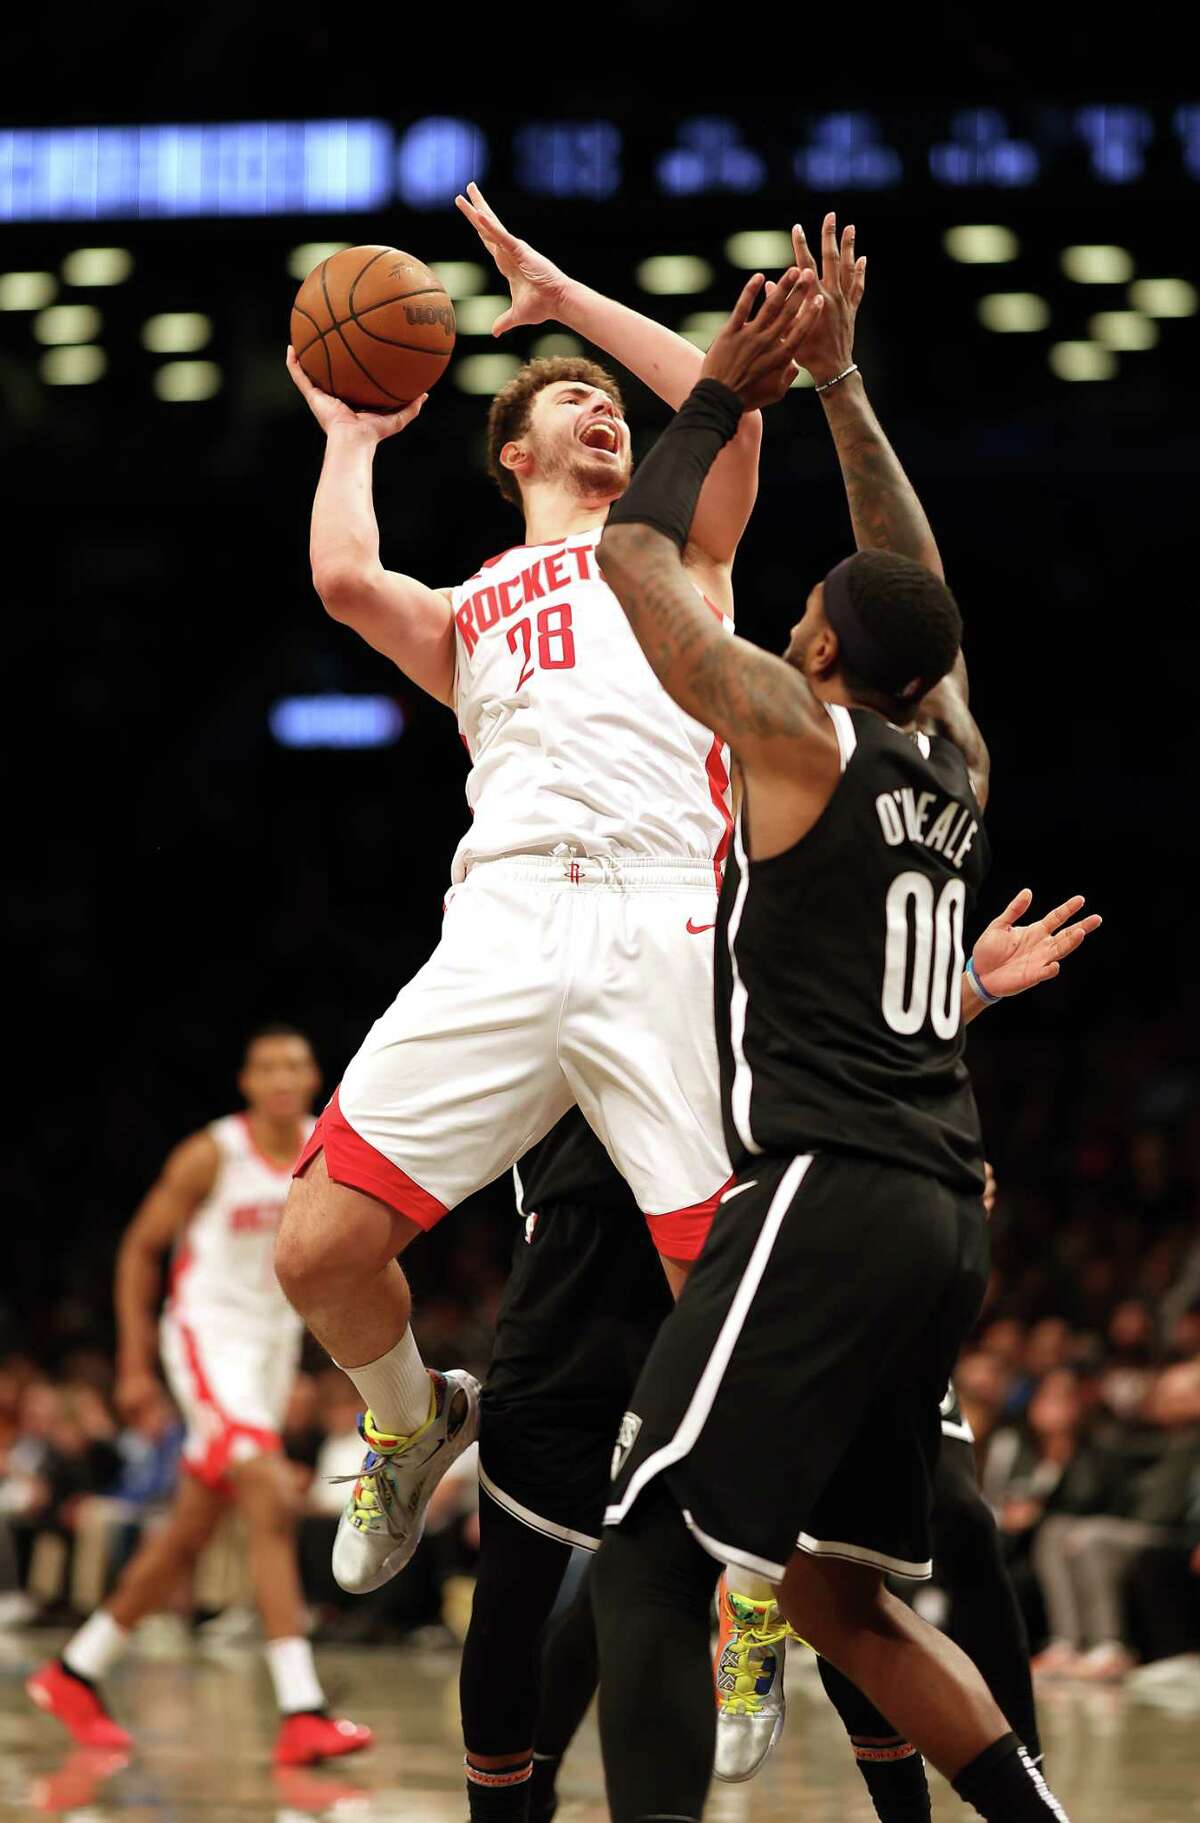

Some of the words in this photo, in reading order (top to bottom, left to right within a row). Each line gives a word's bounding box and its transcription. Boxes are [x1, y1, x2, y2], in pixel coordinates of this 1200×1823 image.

[455, 543, 604, 658] ROCKET
[506, 602, 576, 693] 28
[881, 870, 966, 1041] 00
